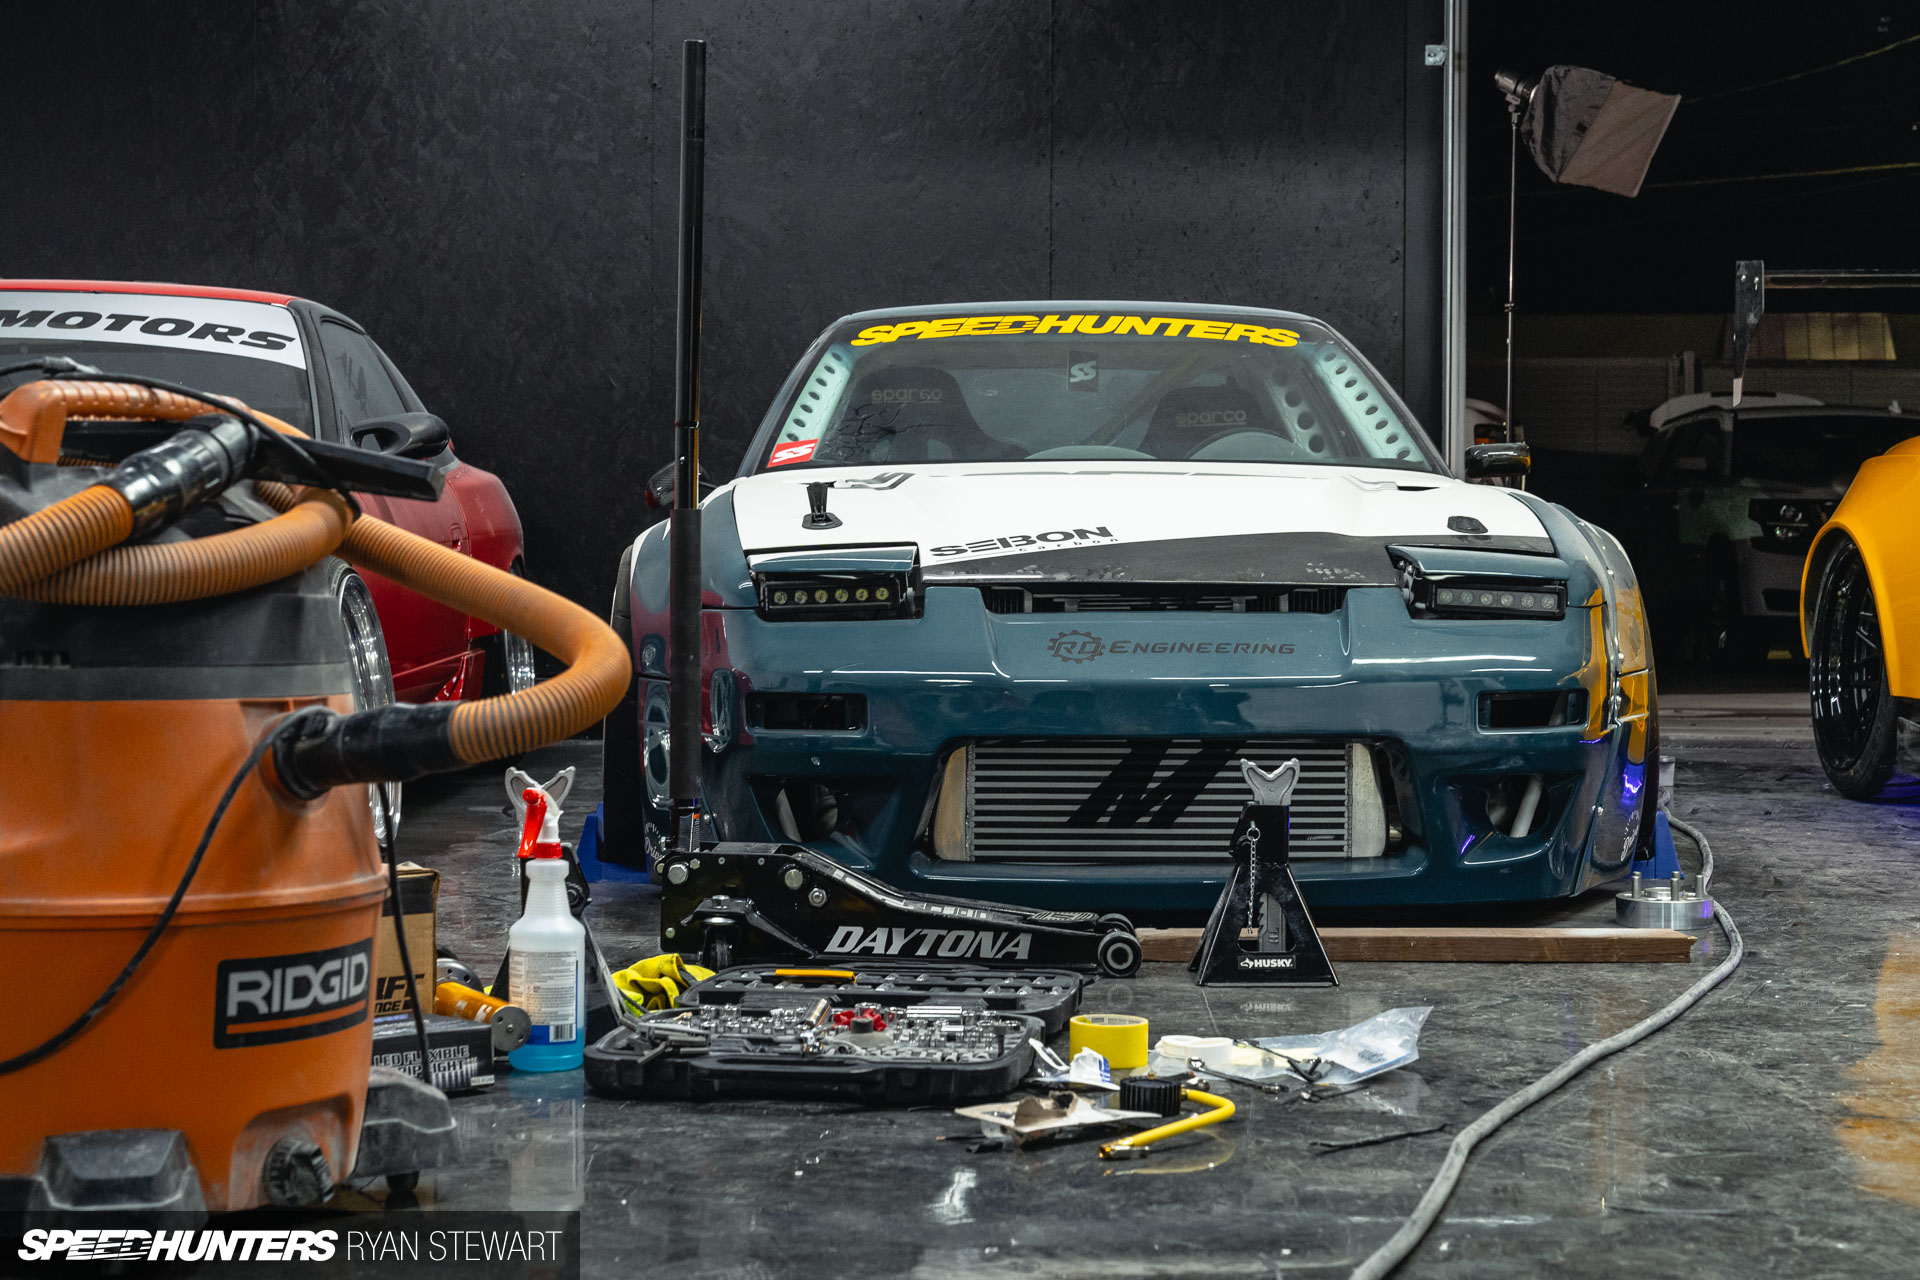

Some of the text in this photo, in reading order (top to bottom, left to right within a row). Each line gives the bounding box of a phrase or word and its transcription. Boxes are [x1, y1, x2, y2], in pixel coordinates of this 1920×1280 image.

[0, 310, 296, 350] MOTORS
[850, 314, 1301, 347] SPEEDHUNTERS
[1175, 409, 1247, 428] sparco
[930, 526, 1113, 557] SEBON
[1019, 538, 1118, 552] carbon
[1108, 639, 1296, 655] ENGINEERING
[824, 925, 1033, 960] DAYTONA
[1254, 958, 1293, 968] HUSKY
[226, 952, 369, 1017] RIDGID
[374, 1045, 470, 1068] LED FLXIBLE
[430, 1059, 465, 1074] IGHT
